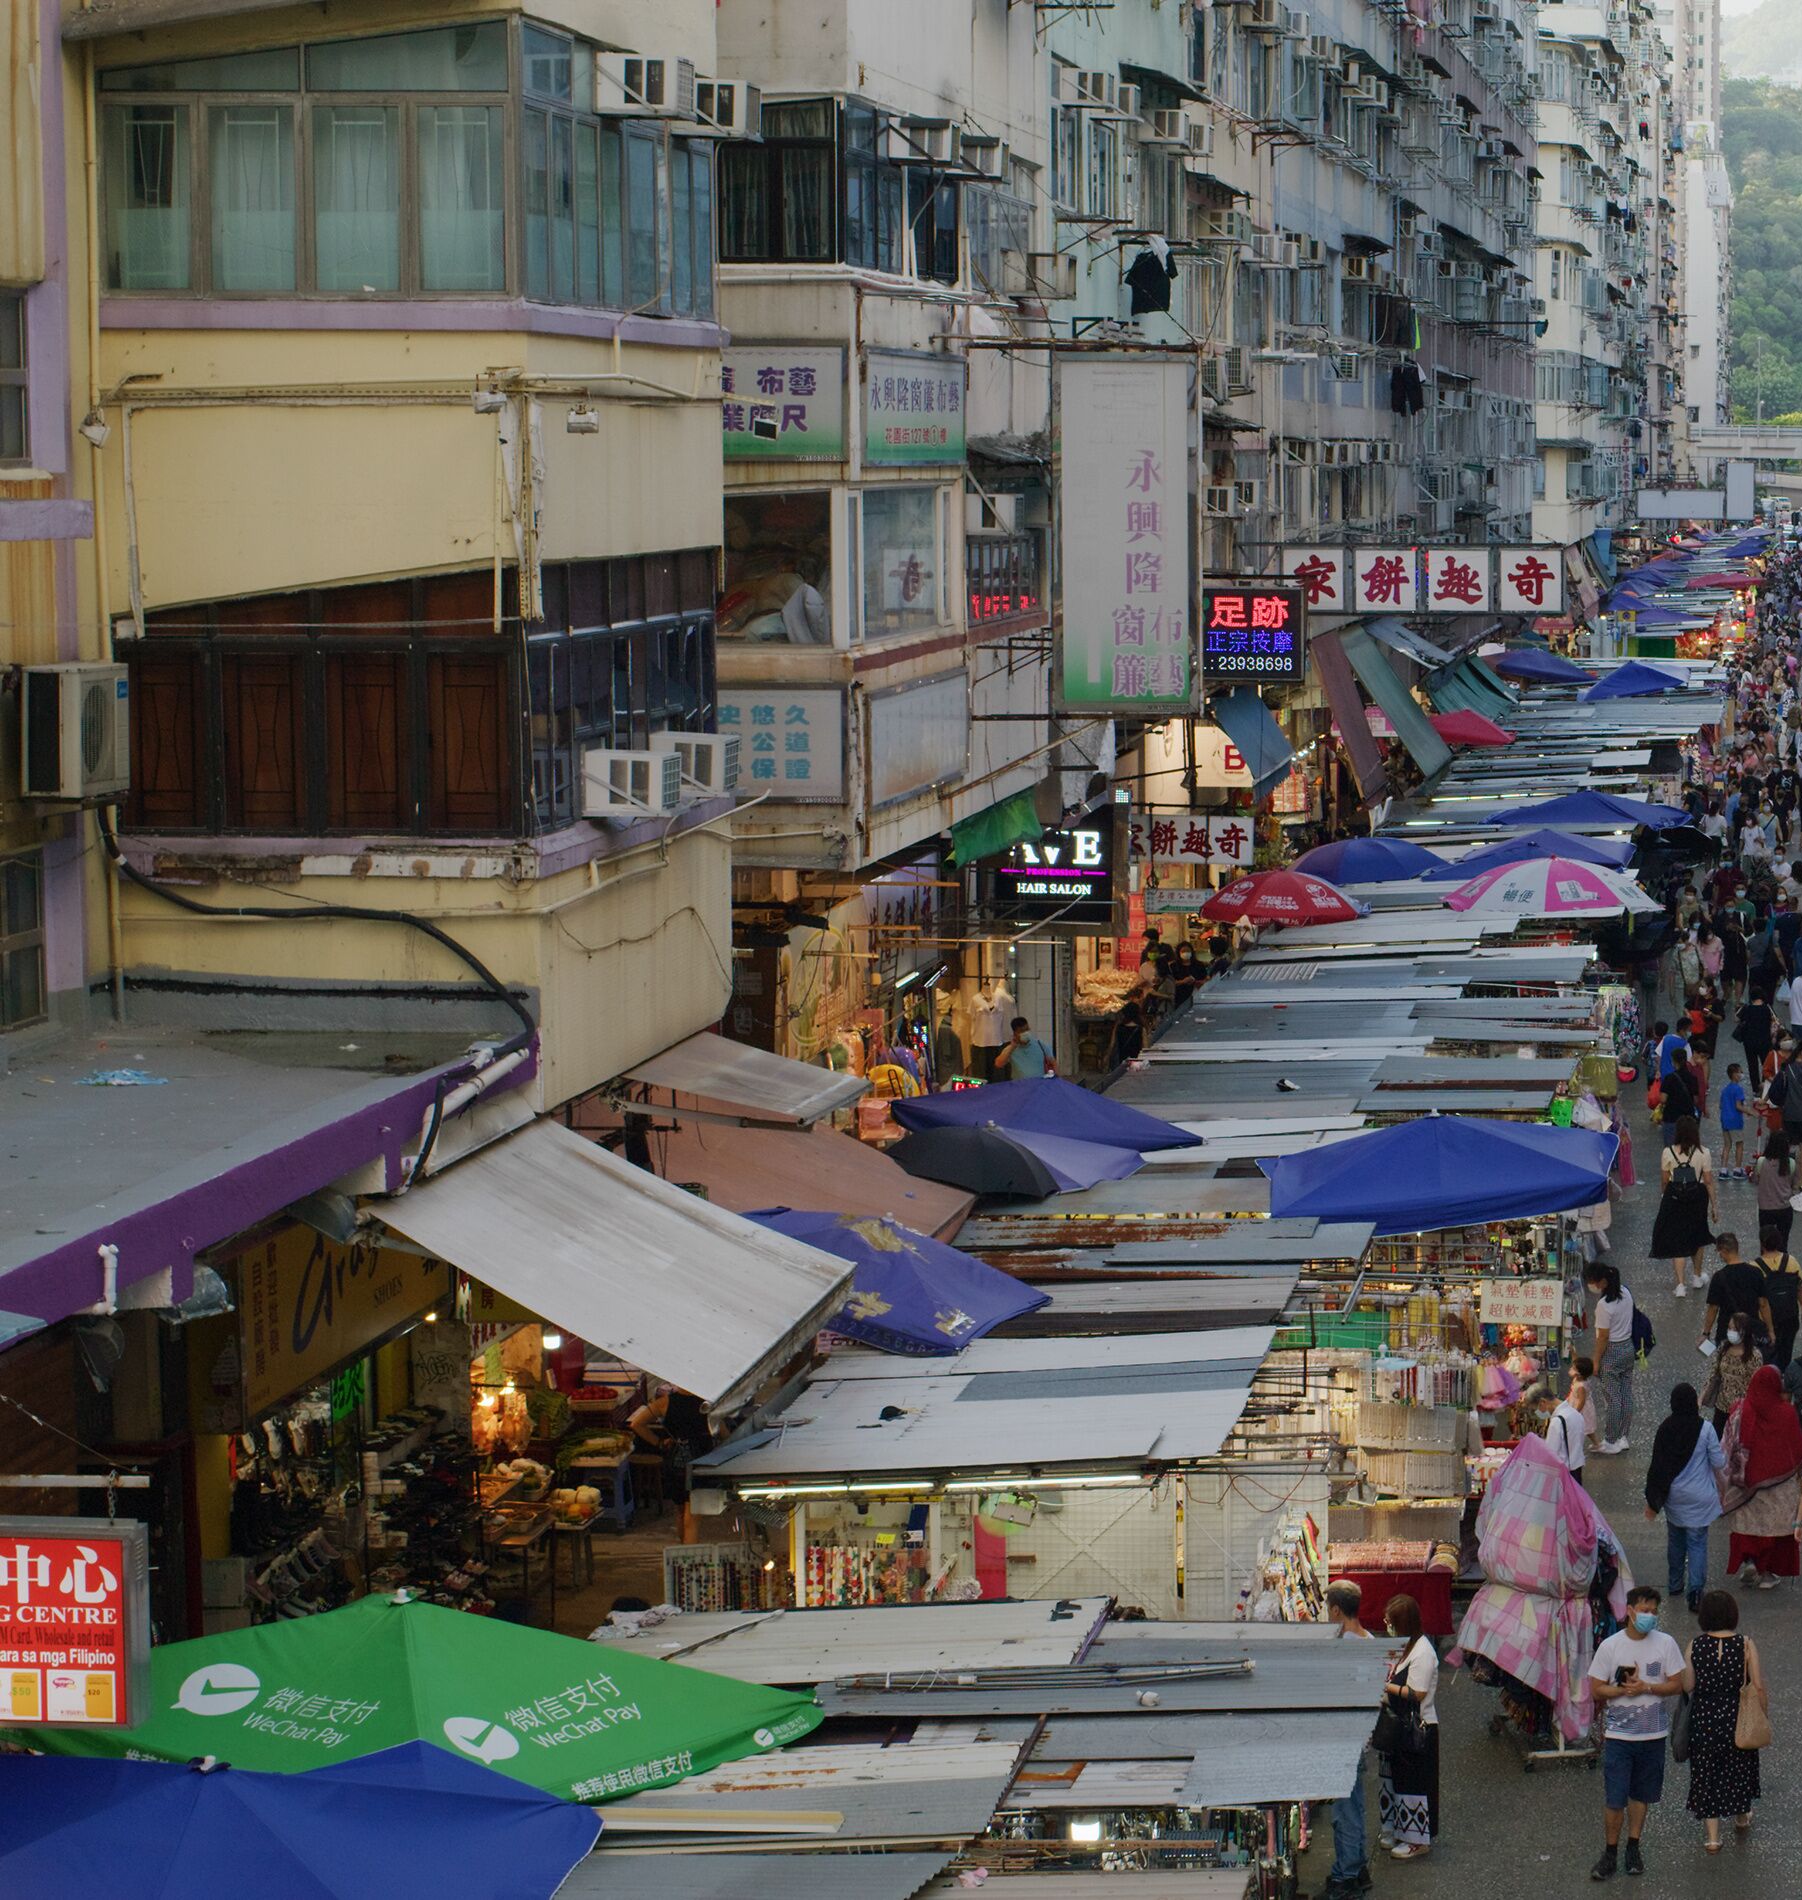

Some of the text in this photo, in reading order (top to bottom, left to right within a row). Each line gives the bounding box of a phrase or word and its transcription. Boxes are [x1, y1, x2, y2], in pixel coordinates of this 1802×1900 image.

[1210, 595, 1289, 629] 足跡
[1205, 630, 1293, 653] 正宗按摩
[1017, 883, 1092, 896] HAIR SALON
[0, 1544, 118, 1604] 中心
[16, 1605, 118, 1625] CENTRE
[35, 1626, 75, 1646] Wholesale
[77, 1628, 93, 1647] and
[94, 1628, 115, 1647] retail
[22, 1652, 37, 1664] sa
[40, 1653, 67, 1667] mga
[69, 1648, 116, 1668] Filipino
[263, 1686, 381, 1725] 微信支付
[504, 1672, 622, 1733] 微信支付
[243, 1712, 351, 1749] WeChat Pay
[529, 1701, 643, 1750] WeChat Pay
[571, 1750, 693, 1802] 推荐使用微信支付
